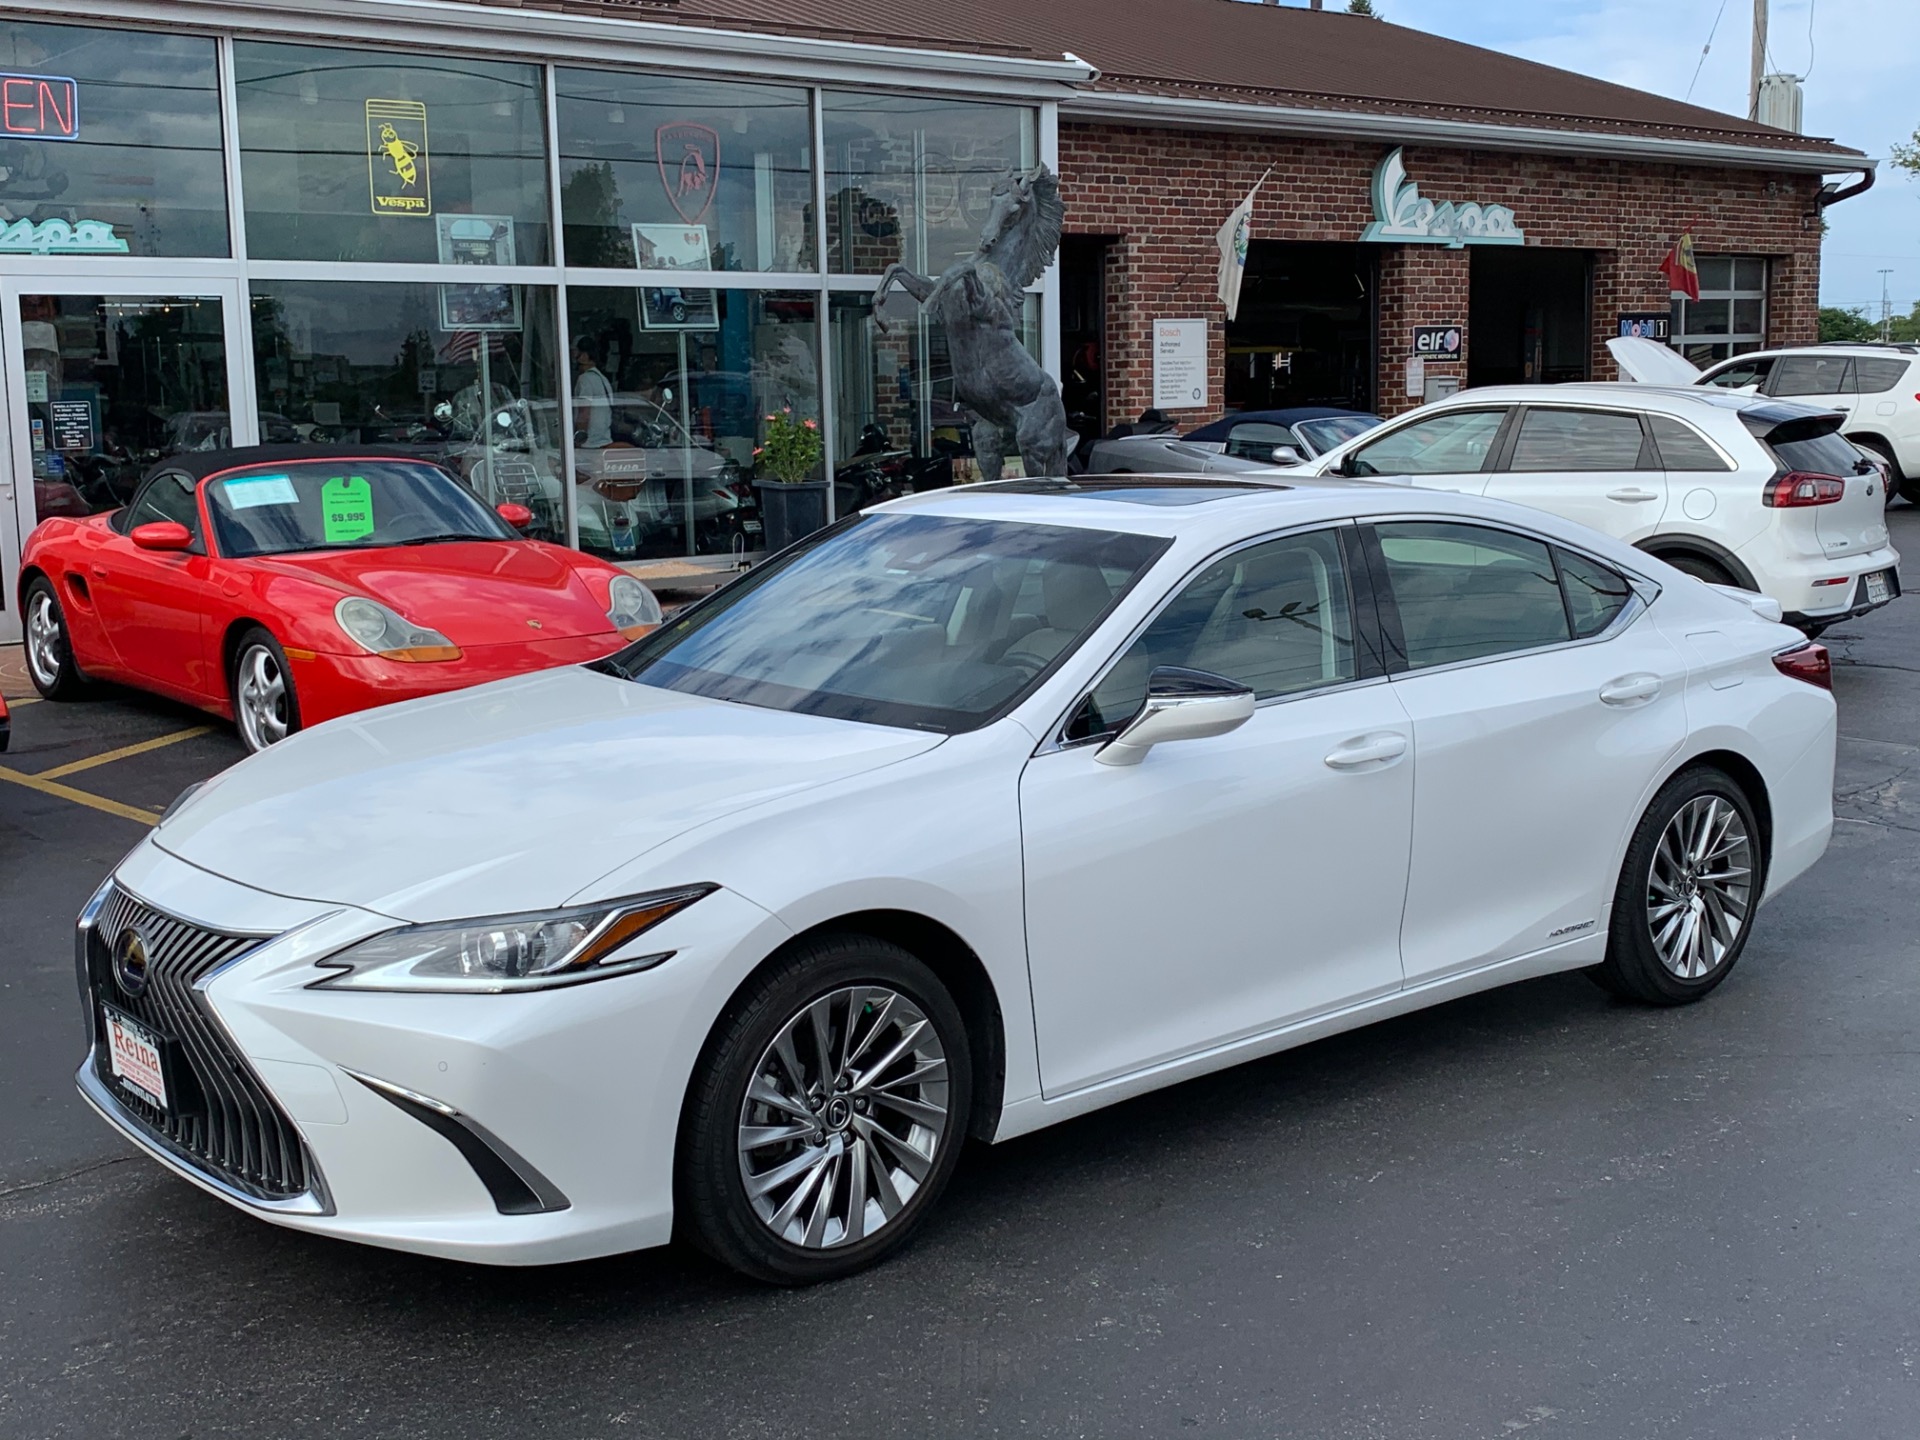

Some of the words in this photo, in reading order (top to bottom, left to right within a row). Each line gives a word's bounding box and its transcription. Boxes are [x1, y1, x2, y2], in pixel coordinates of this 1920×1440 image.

[376, 196, 426, 210] Vespa
[1373, 147, 1523, 245] Vespa
[0, 218, 126, 254] spa
[1160, 328, 1181, 337] Bosch
[1621, 319, 1655, 338] Mobil
[1657, 320, 1665, 337] 1
[1417, 331, 1444, 350] elf
[331, 512, 366, 523] $9,995
[112, 1021, 160, 1075] Reina
